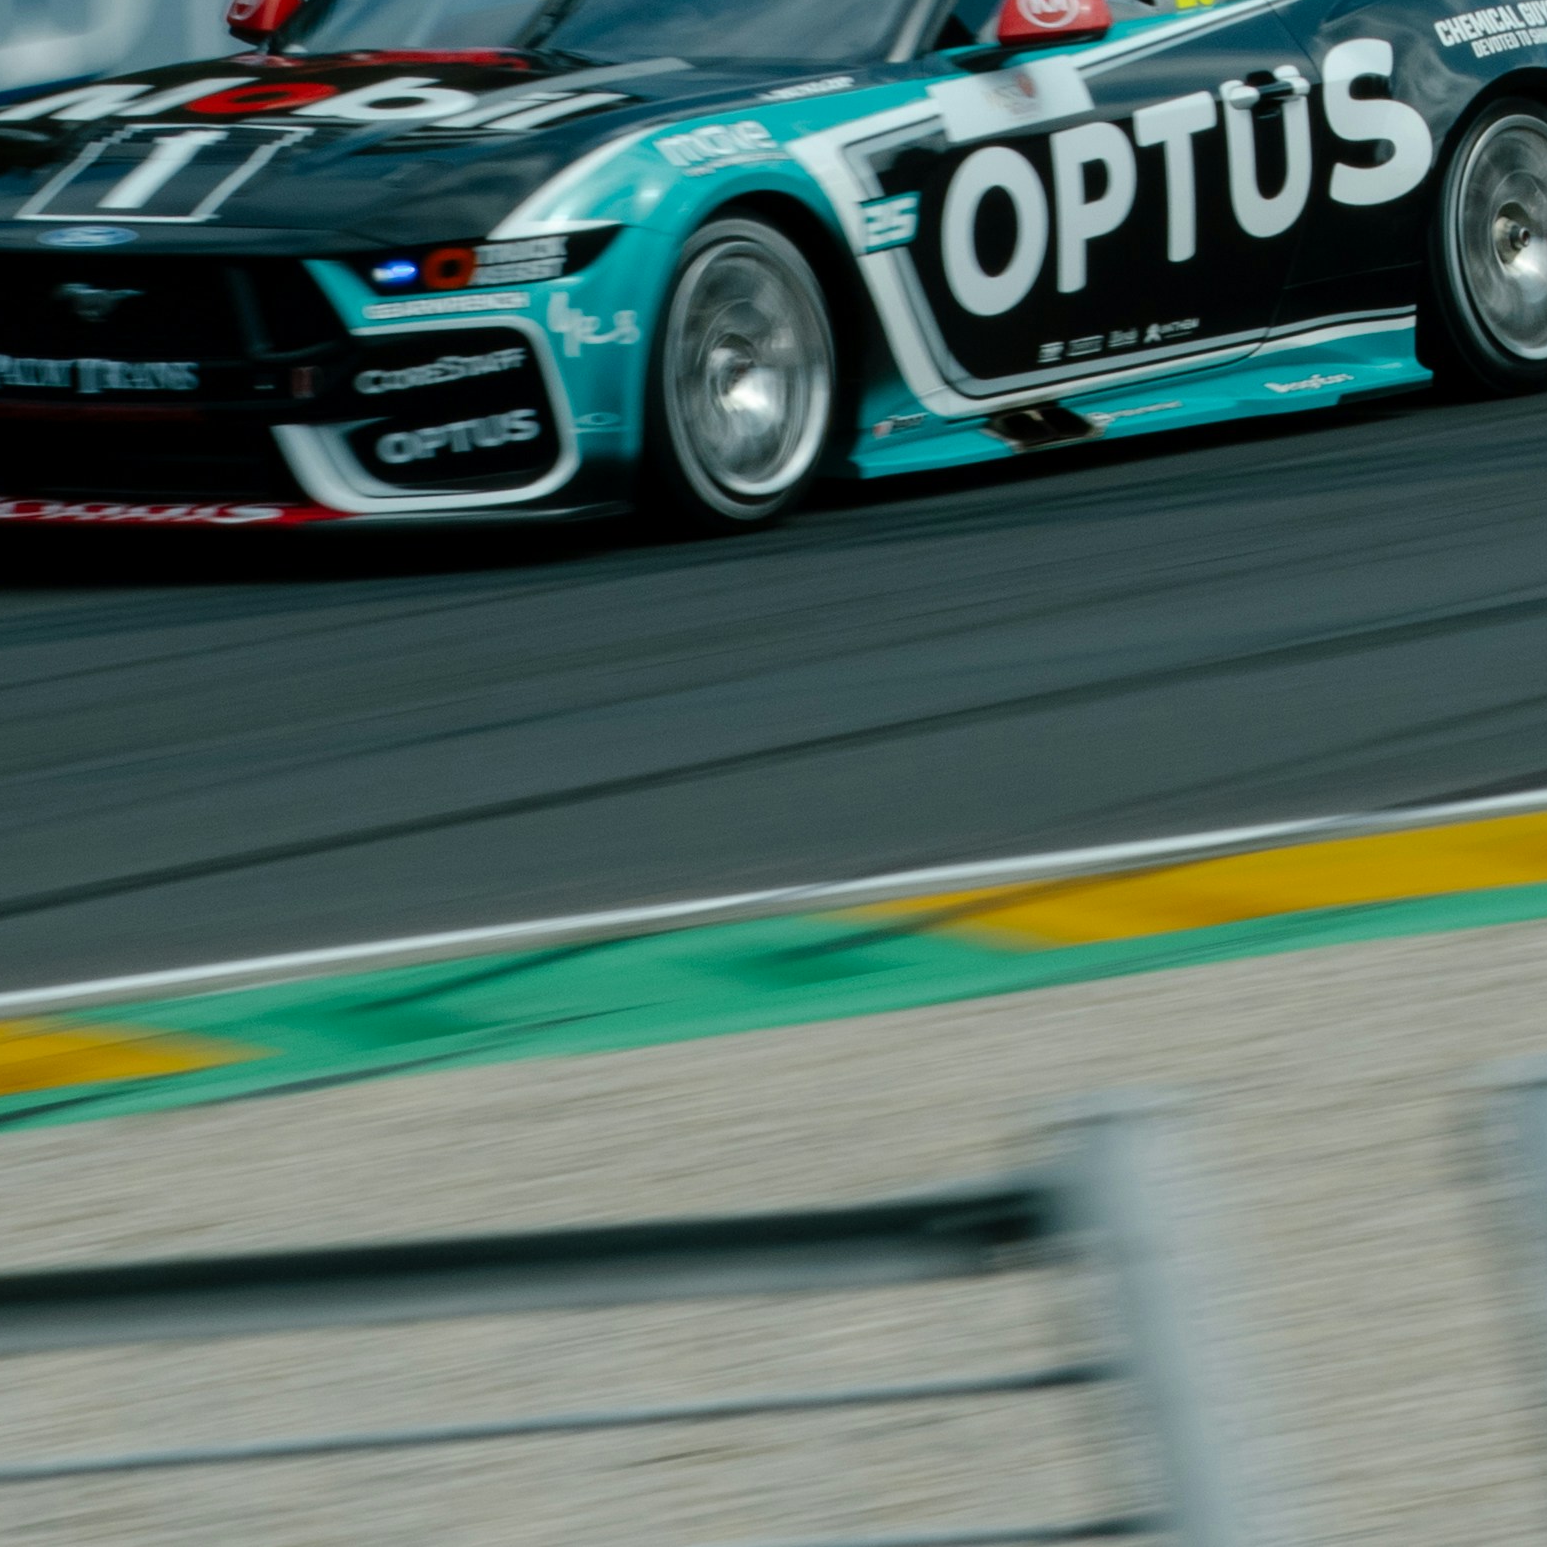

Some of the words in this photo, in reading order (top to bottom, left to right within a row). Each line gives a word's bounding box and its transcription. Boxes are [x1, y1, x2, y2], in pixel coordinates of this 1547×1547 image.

[1433, 4, 1526, 48] CHEMICAL
[1471, 29, 1519, 59] DEVOTED
[96, 130, 229, 209] 1
[940, 37, 1434, 318] OPTUS
[375, 408, 542, 464] OPTUS
